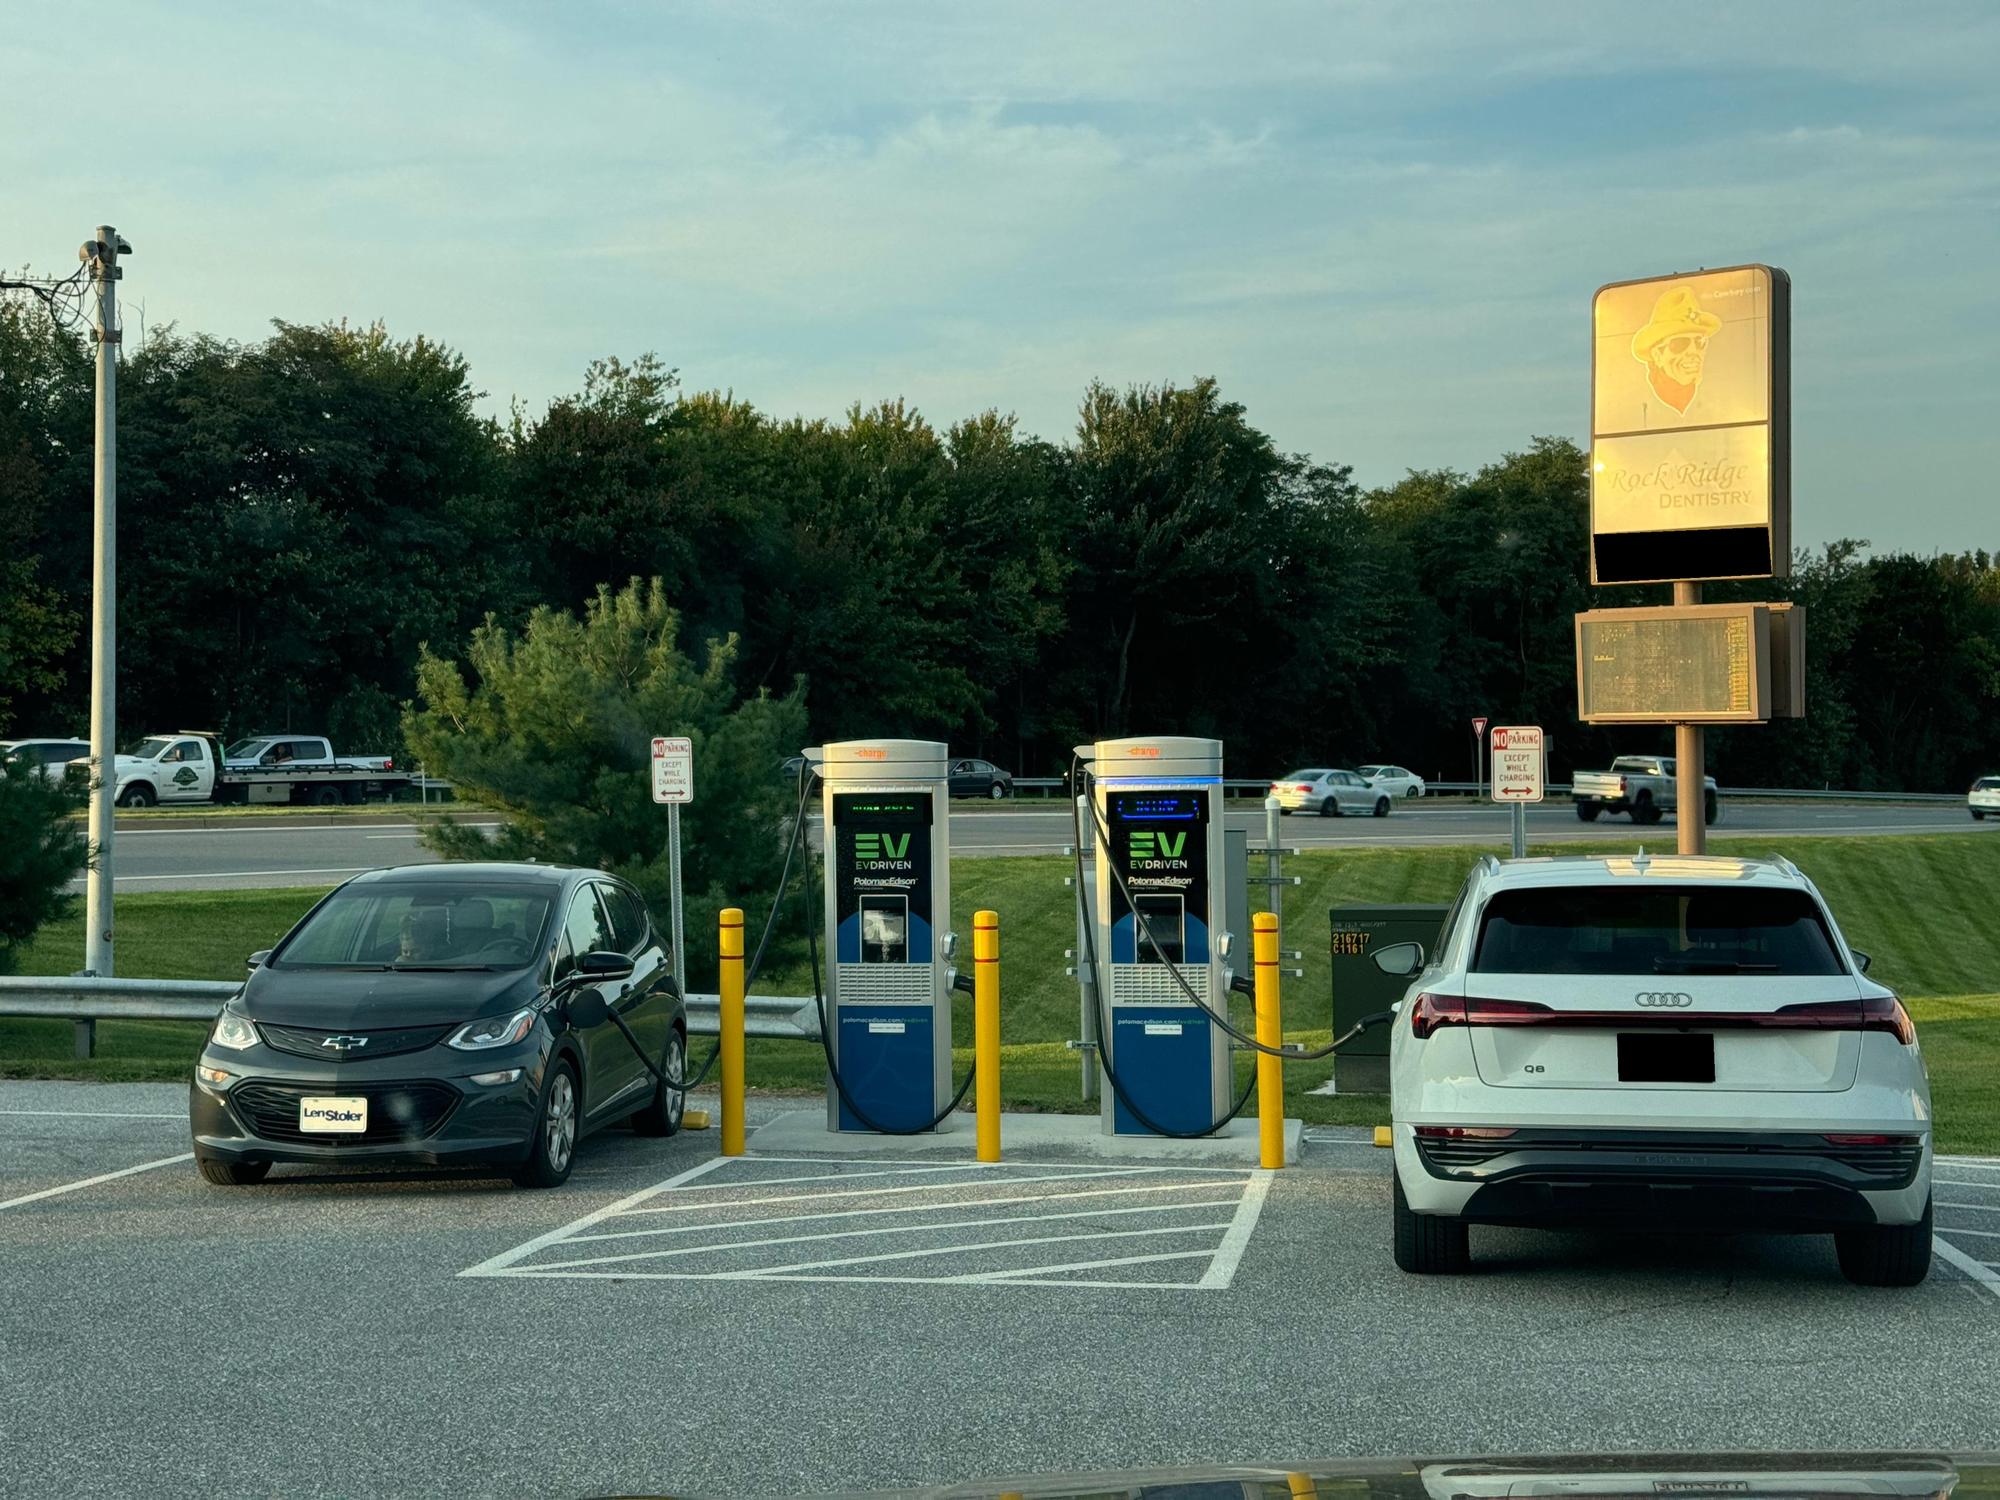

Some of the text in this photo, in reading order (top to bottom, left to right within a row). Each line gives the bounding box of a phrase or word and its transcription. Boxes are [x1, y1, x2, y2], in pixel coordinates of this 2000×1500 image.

[1609, 458, 1749, 493] Rock Ridge
[1659, 490, 1752, 509] DENTISTRY
[1494, 732, 1538, 747] NO PARKING
[653, 742, 688, 756] NO PARKING
[1503, 754, 1530, 762] EXCEPT
[661, 761, 682, 769] EXCEPT
[1506, 764, 1528, 772] WHILE
[1499, 774, 1535, 782] CHARGING
[855, 860, 912, 870] EVDRIVEN
[1130, 860, 1188, 869] EVDRIVEN
[1332, 933, 1370, 944] 216717
[1333, 943, 1364, 954] C1161
[1524, 1065, 1545, 1073] Q8
